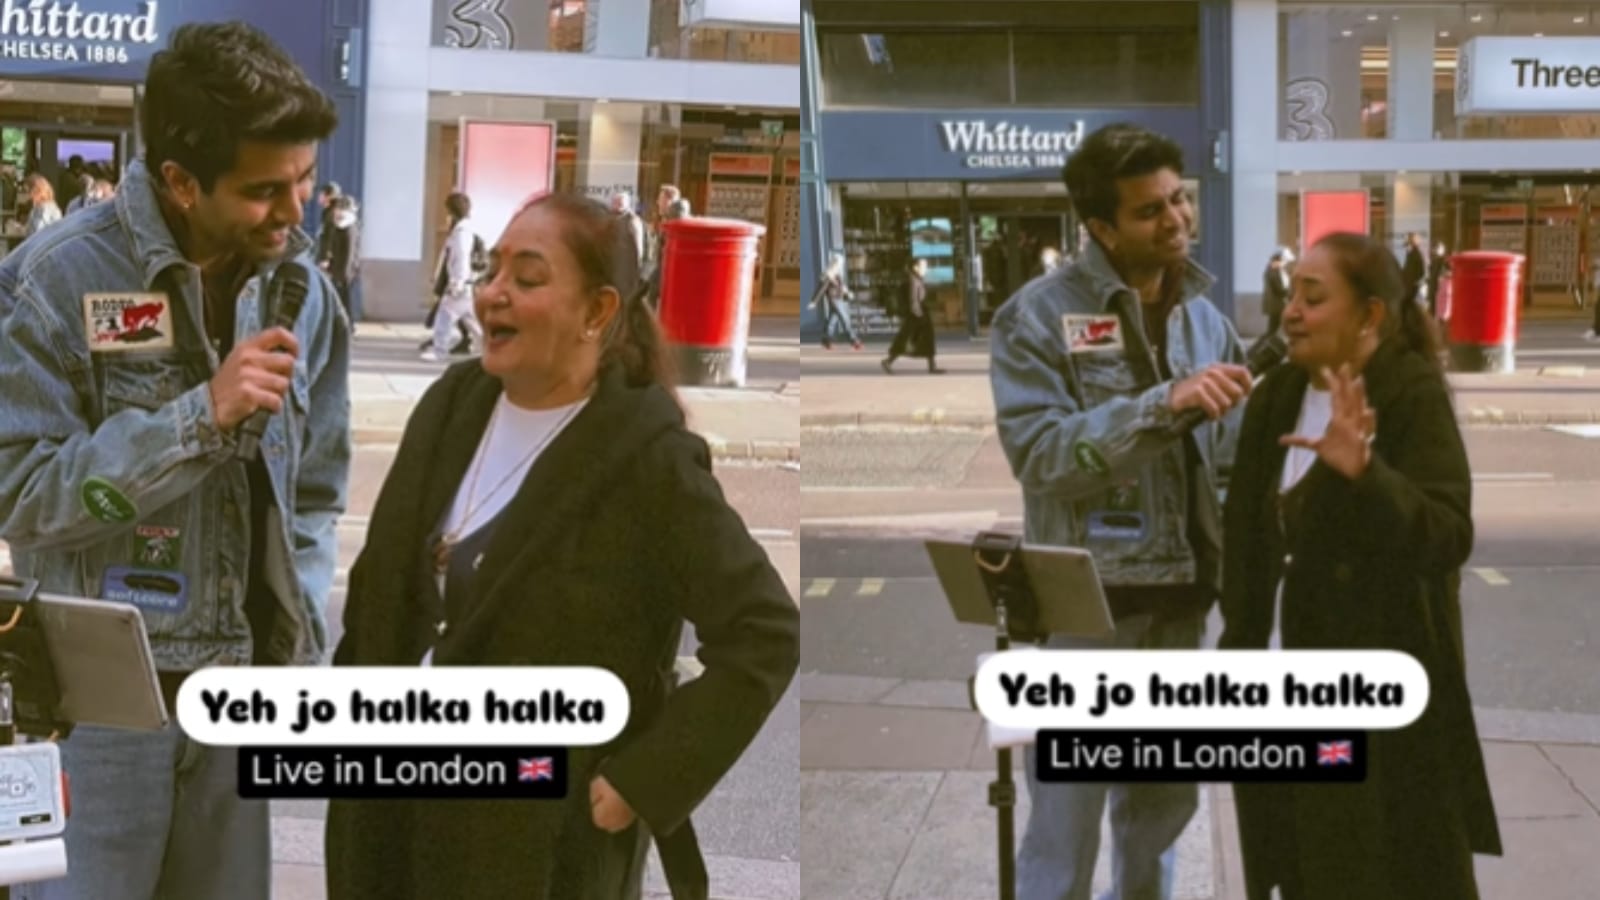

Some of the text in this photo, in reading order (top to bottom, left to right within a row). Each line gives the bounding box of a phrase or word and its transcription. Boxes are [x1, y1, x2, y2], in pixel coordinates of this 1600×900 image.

[87, 44, 129, 63] 1886
[1511, 58, 1600, 88] Three
[941, 119, 1085, 153] Whittard
[966, 154, 1031, 168] CHELSEA
